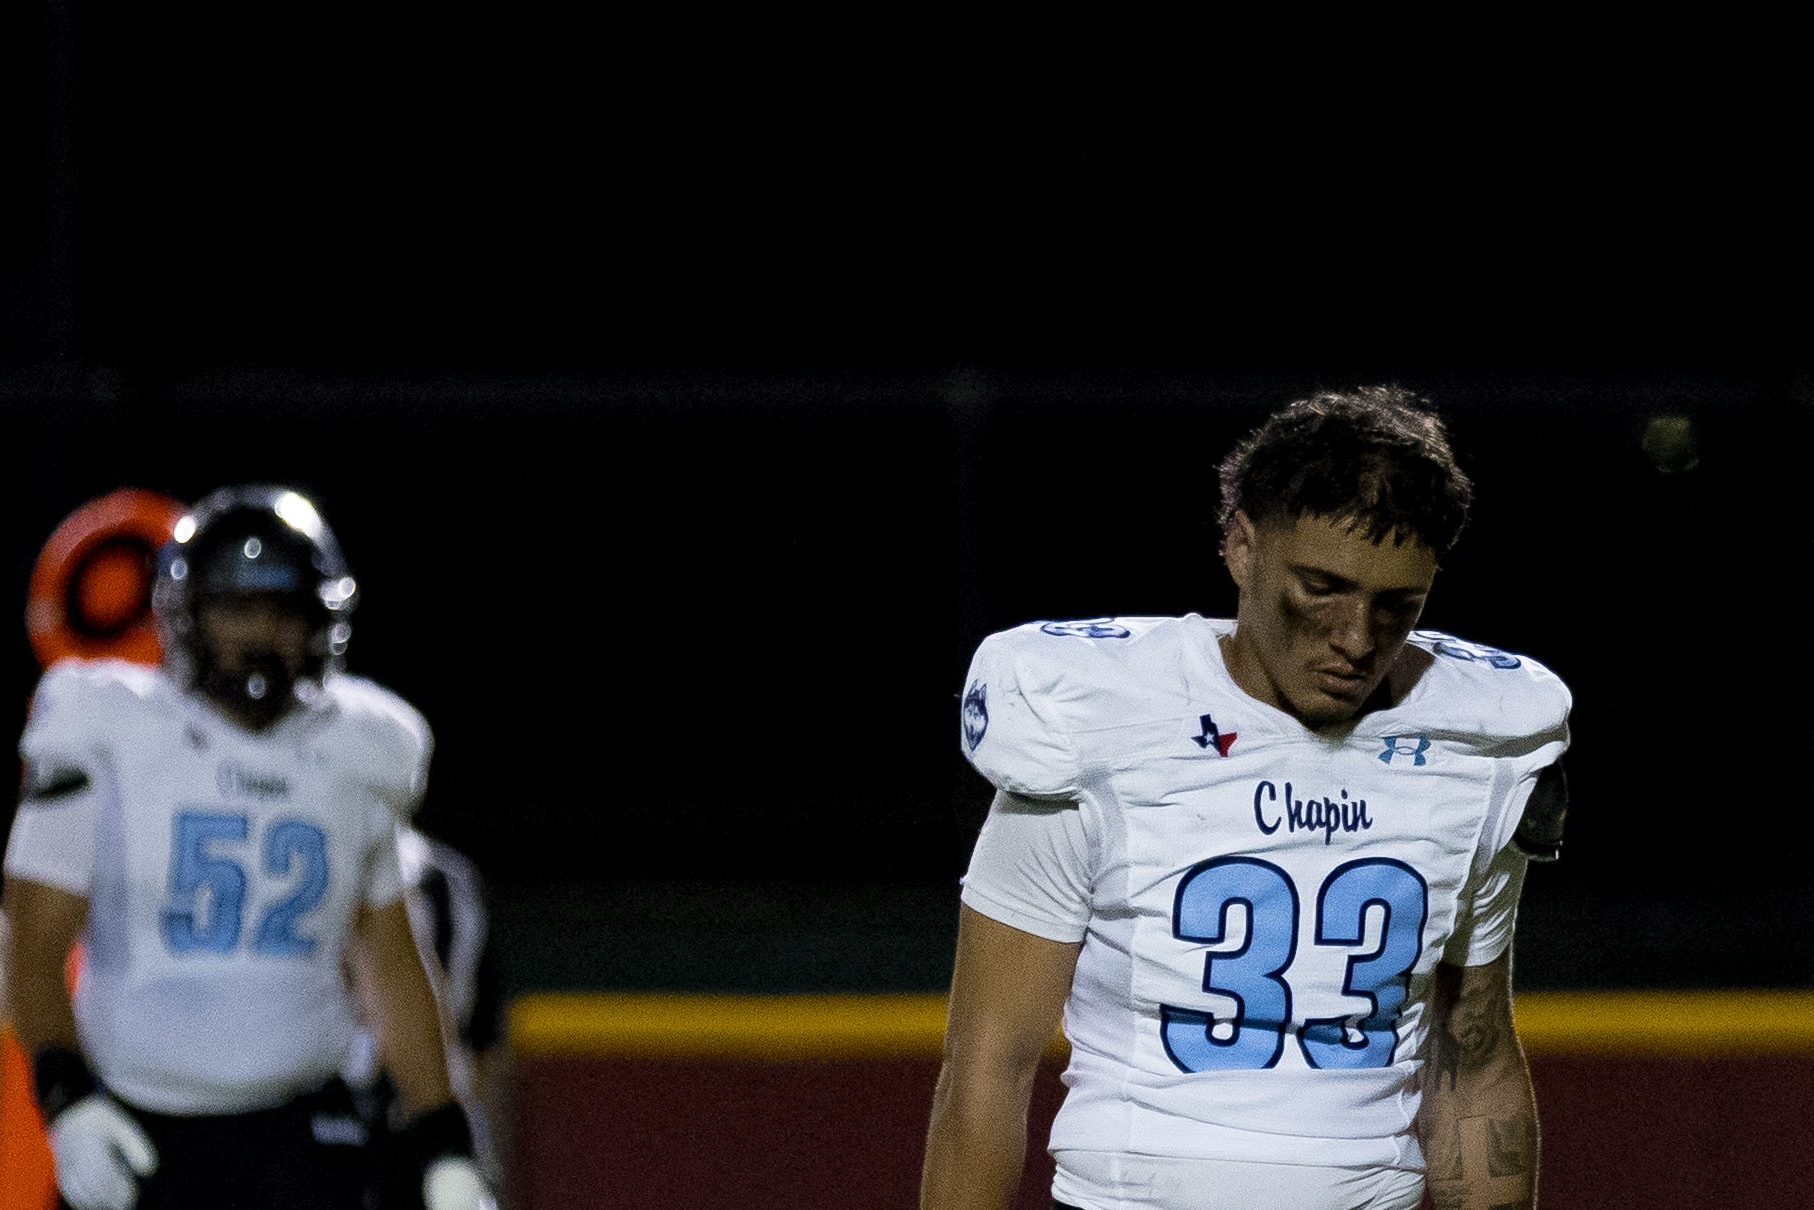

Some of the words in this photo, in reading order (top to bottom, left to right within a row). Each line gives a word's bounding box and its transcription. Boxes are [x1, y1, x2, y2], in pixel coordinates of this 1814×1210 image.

[158, 809, 330, 960] 52
[1253, 780, 1373, 846] Chapin
[1159, 856, 1429, 1074] 33
